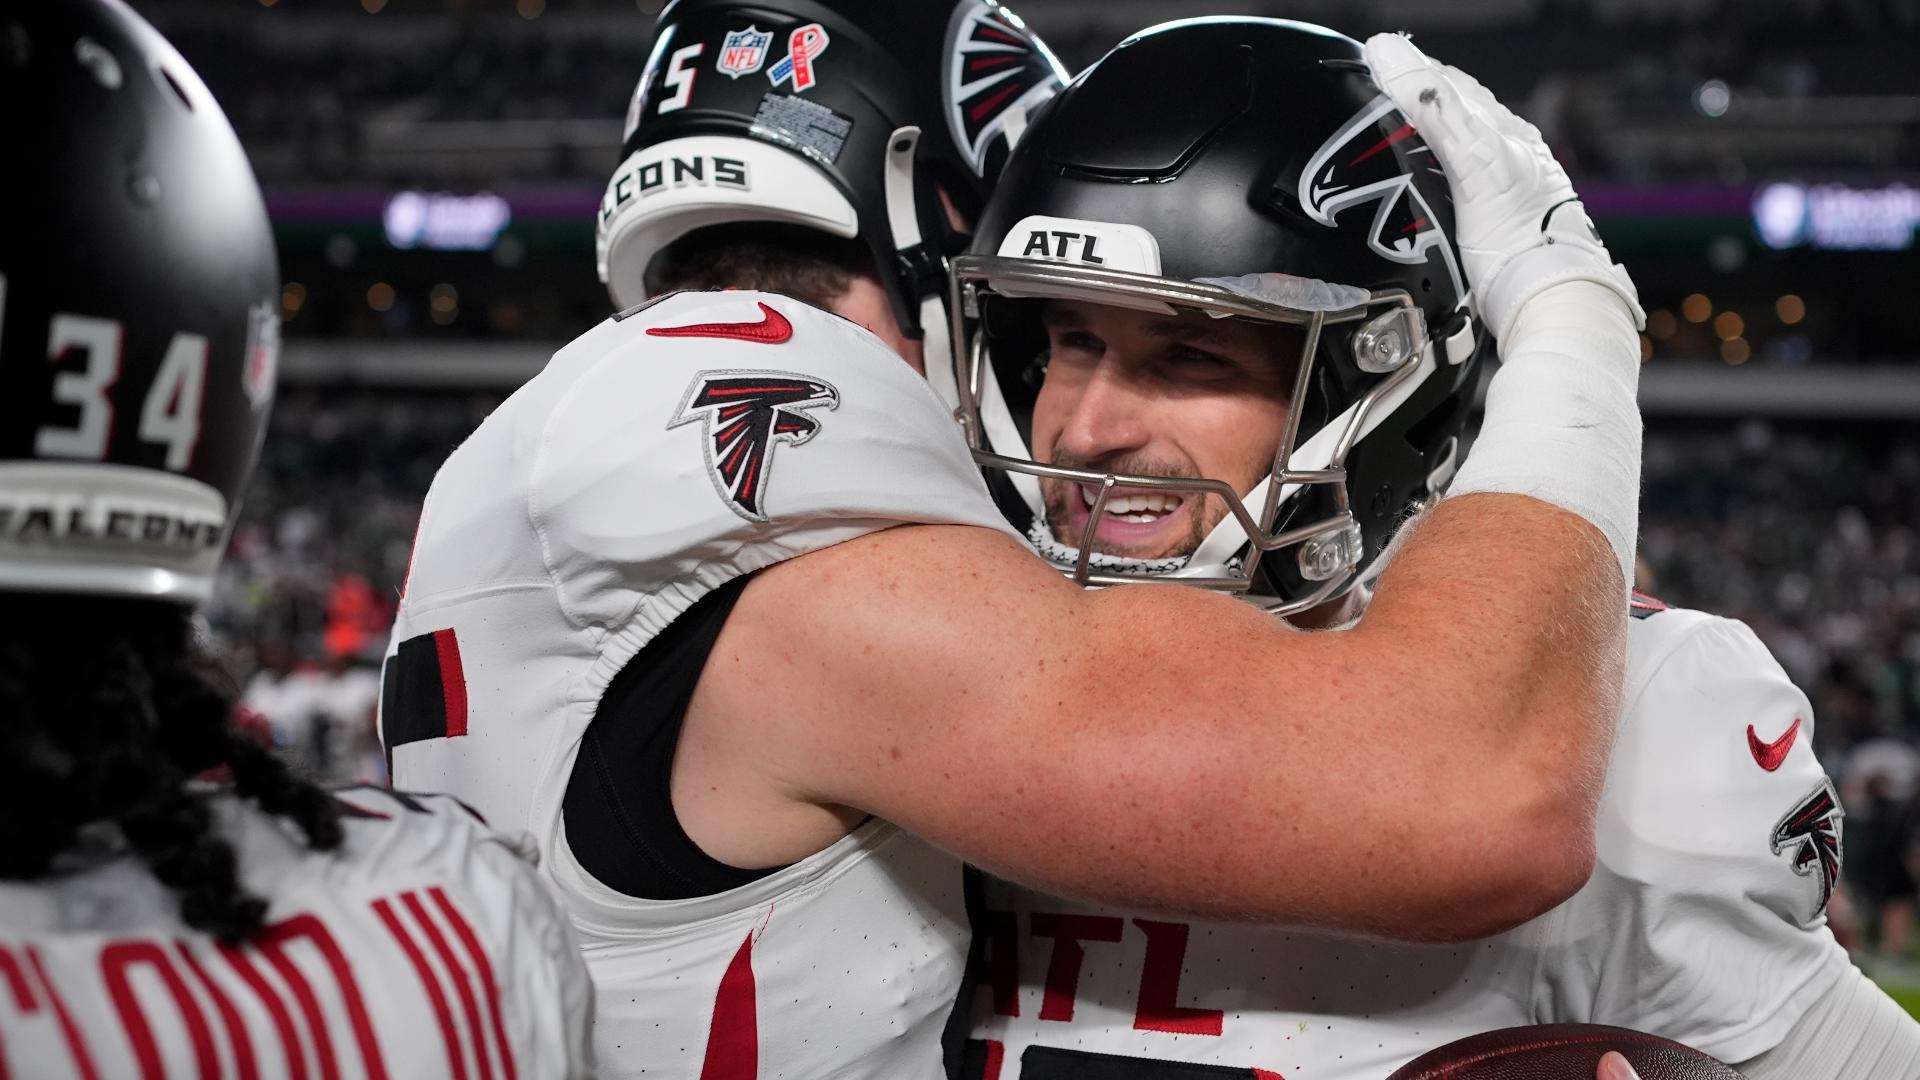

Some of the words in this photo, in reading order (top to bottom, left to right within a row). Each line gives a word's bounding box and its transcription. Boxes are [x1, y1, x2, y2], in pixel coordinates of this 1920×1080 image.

[725, 47, 757, 70] NFL
[1022, 231, 1104, 264] ATL
[35, 313, 210, 473] 34
[975, 910, 1225, 1037] ATL
